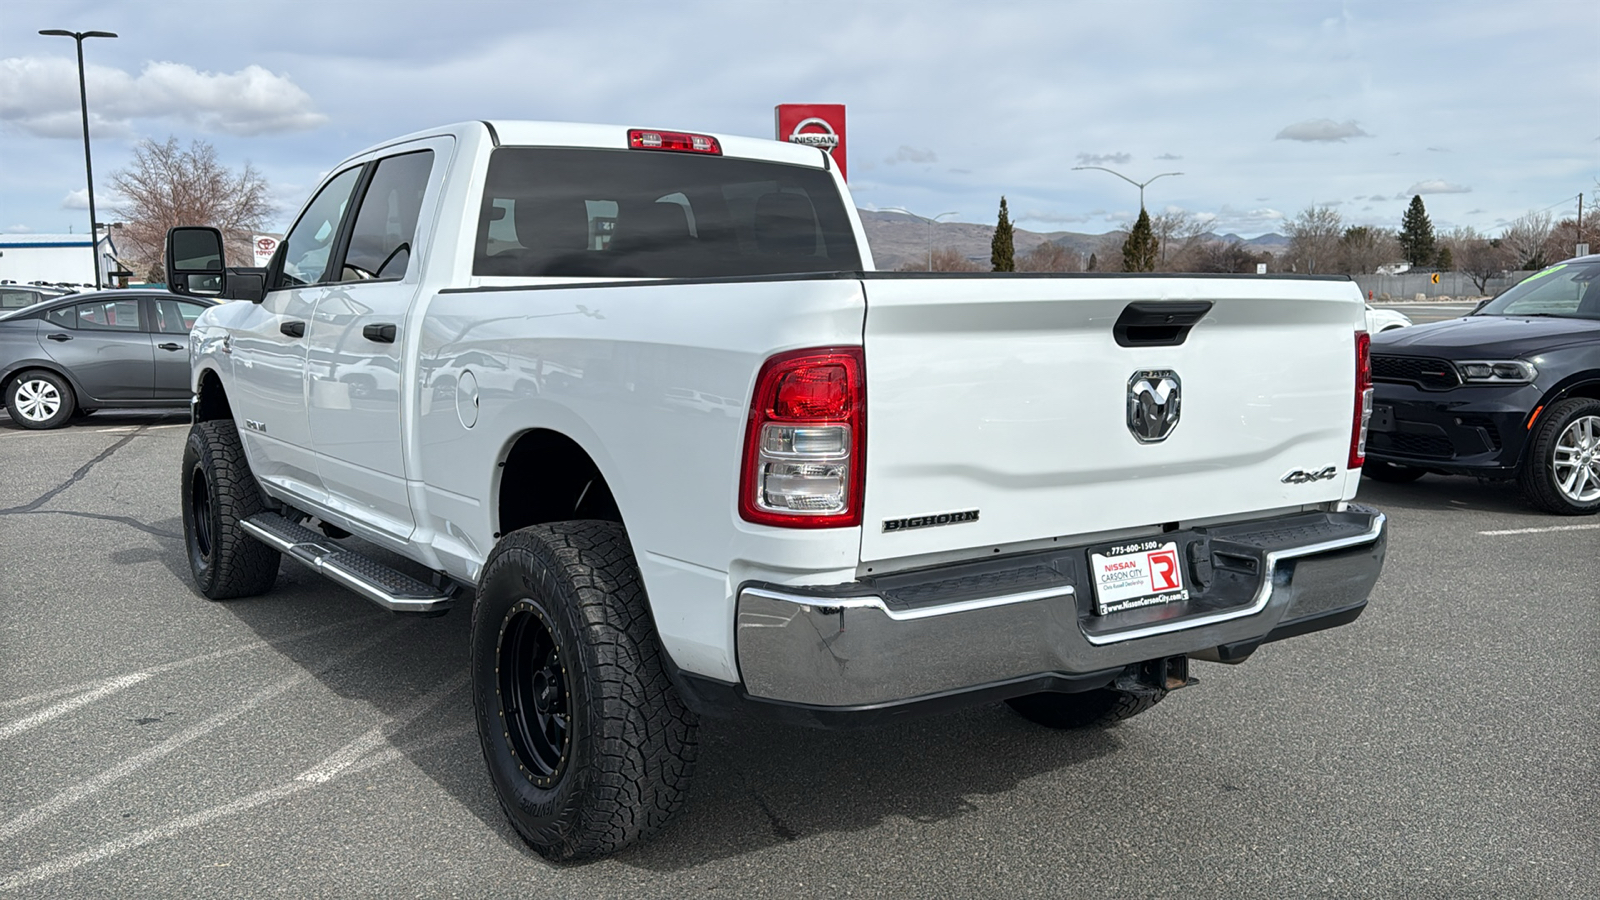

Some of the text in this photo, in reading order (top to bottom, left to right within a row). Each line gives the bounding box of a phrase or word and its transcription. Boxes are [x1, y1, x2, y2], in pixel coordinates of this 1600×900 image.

[794, 136, 835, 144] NISSAN
[882, 509, 980, 533] BIGHORN
[1111, 541, 1158, 554] 775-600-1500
[1104, 561, 1136, 572] NISSAN
[1101, 569, 1143, 582] CARSON CITY
[1107, 594, 1182, 612] www.NissanCarsonCity.com
